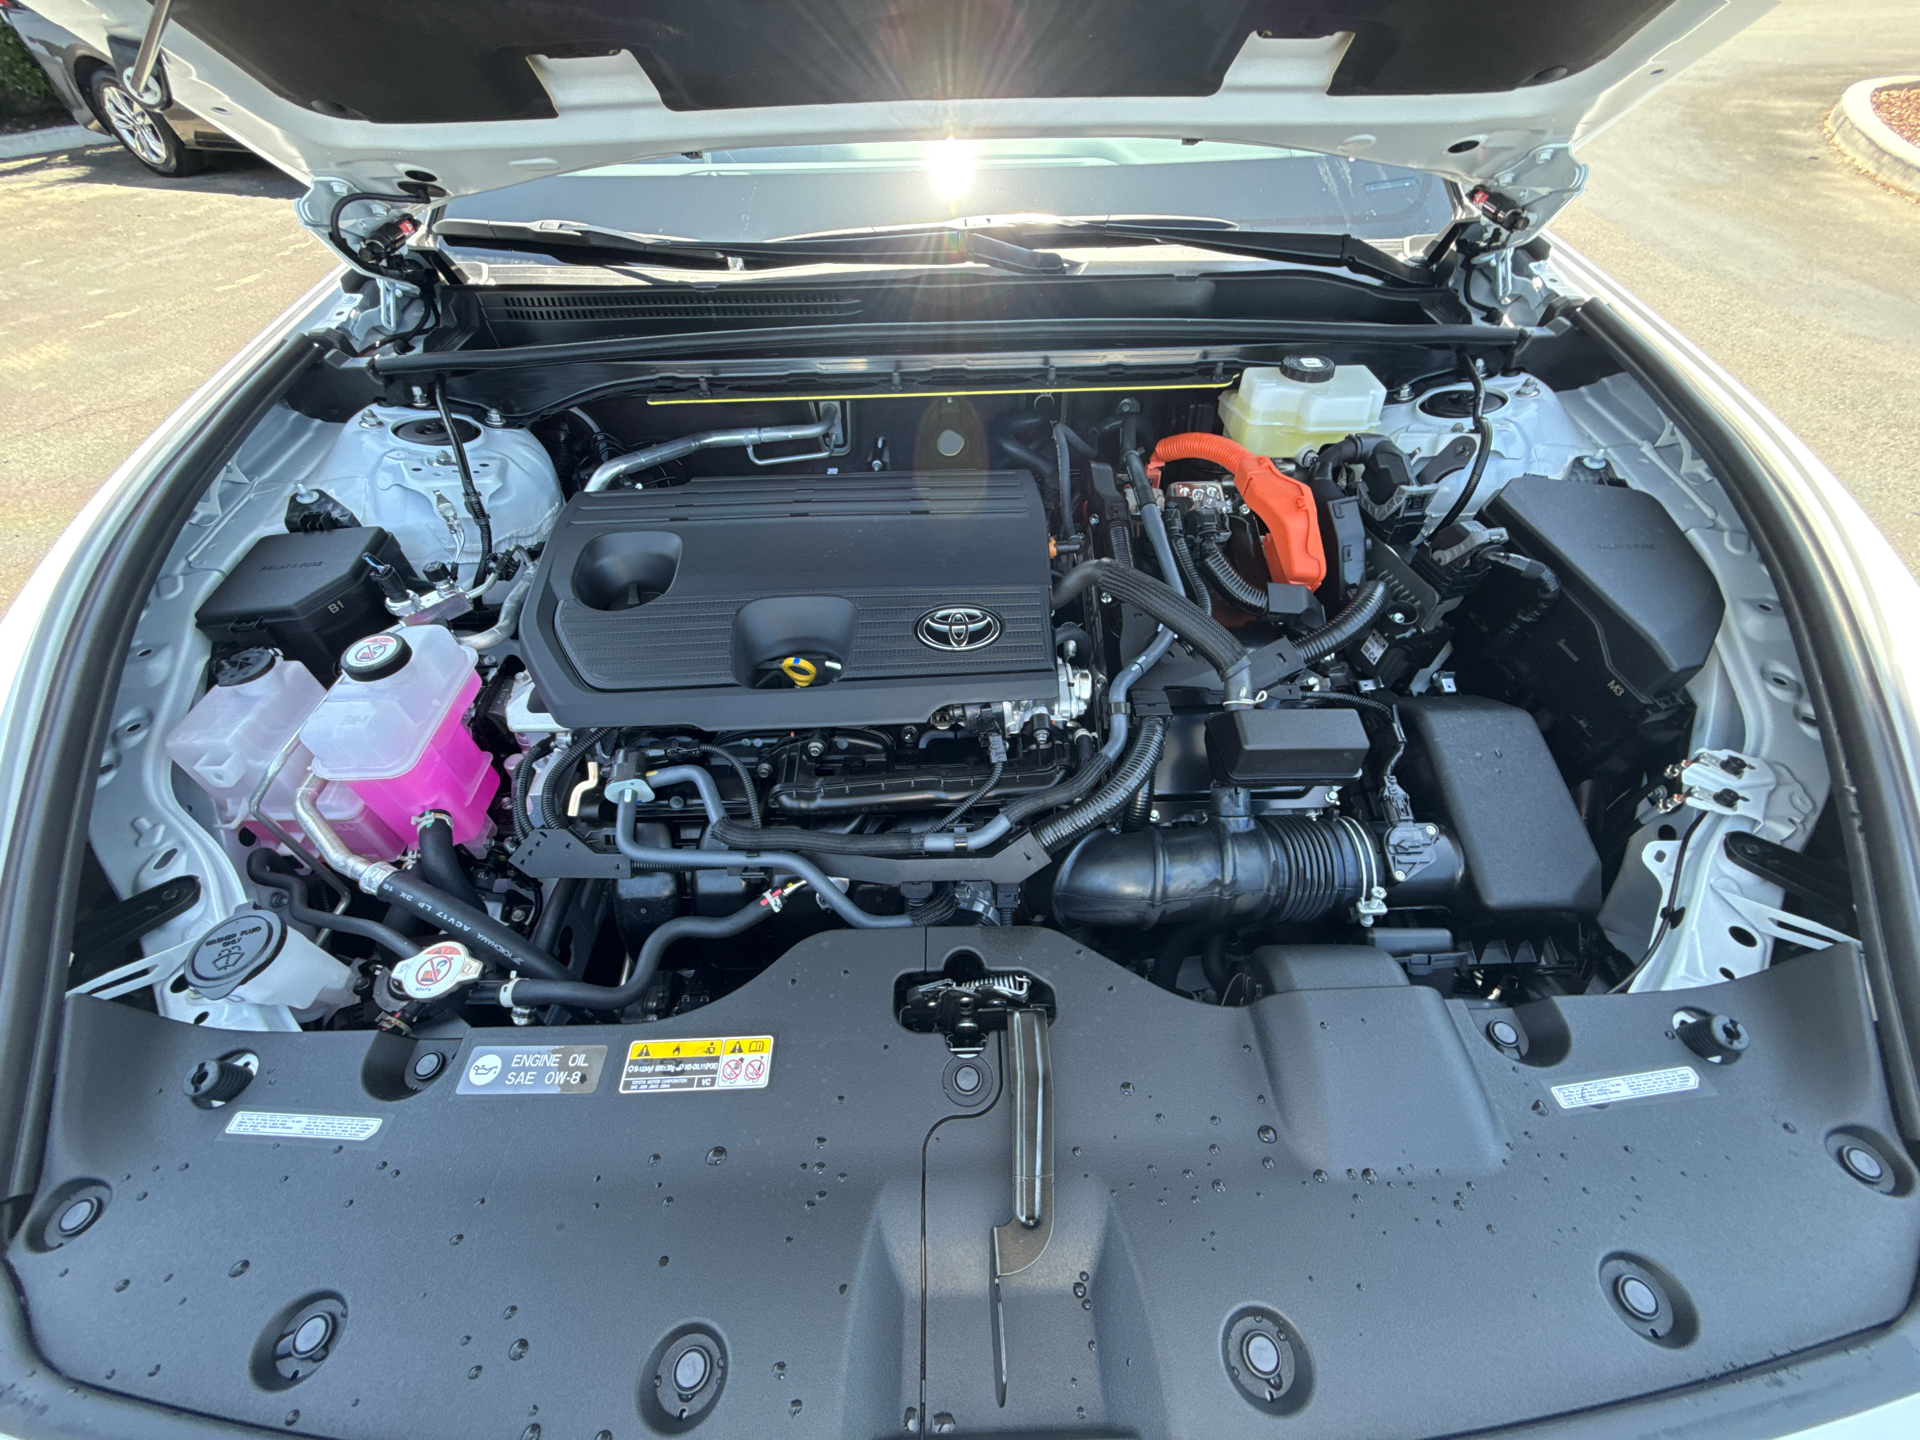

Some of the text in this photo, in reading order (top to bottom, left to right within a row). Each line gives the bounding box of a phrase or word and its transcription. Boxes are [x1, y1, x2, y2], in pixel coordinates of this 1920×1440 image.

[327, 600, 345, 614] B1
[1607, 679, 1625, 697] M3
[399, 892, 413, 902] 3K
[418, 902, 432, 912] LP
[436, 912, 471, 932] ACV17
[477, 932, 514, 959] YOKOHAMA
[511, 1054, 589, 1067] ENGINE OIL
[505, 1071, 537, 1085] SAE
[702, 1078, 712, 1086] VC
